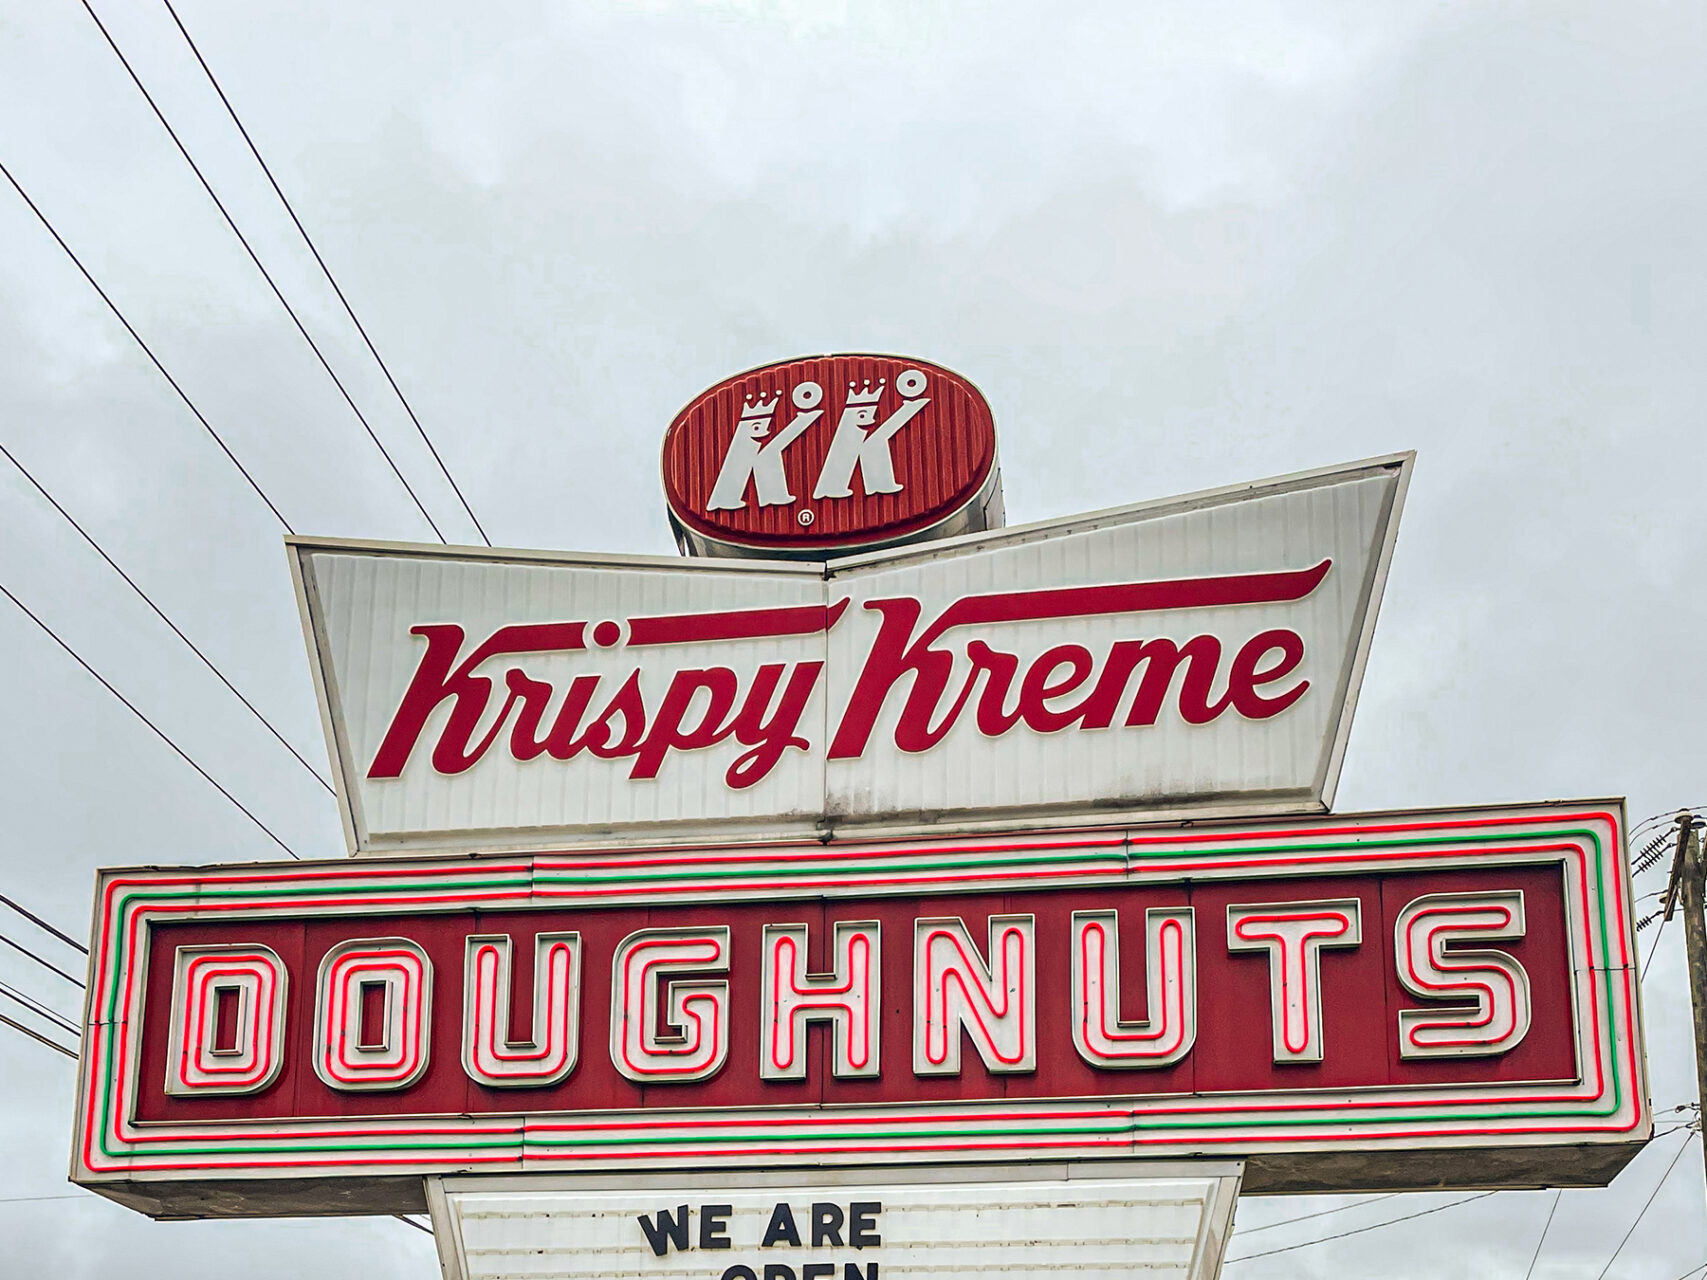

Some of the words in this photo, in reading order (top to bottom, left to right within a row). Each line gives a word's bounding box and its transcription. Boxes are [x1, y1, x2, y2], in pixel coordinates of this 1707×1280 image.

[367, 597, 850, 790] Krispy
[827, 558, 1333, 761] Kreme
[164, 889, 1532, 1095] DOUGHNUTS
[637, 1204, 732, 1257] WE
[761, 1201, 882, 1249] ARE
